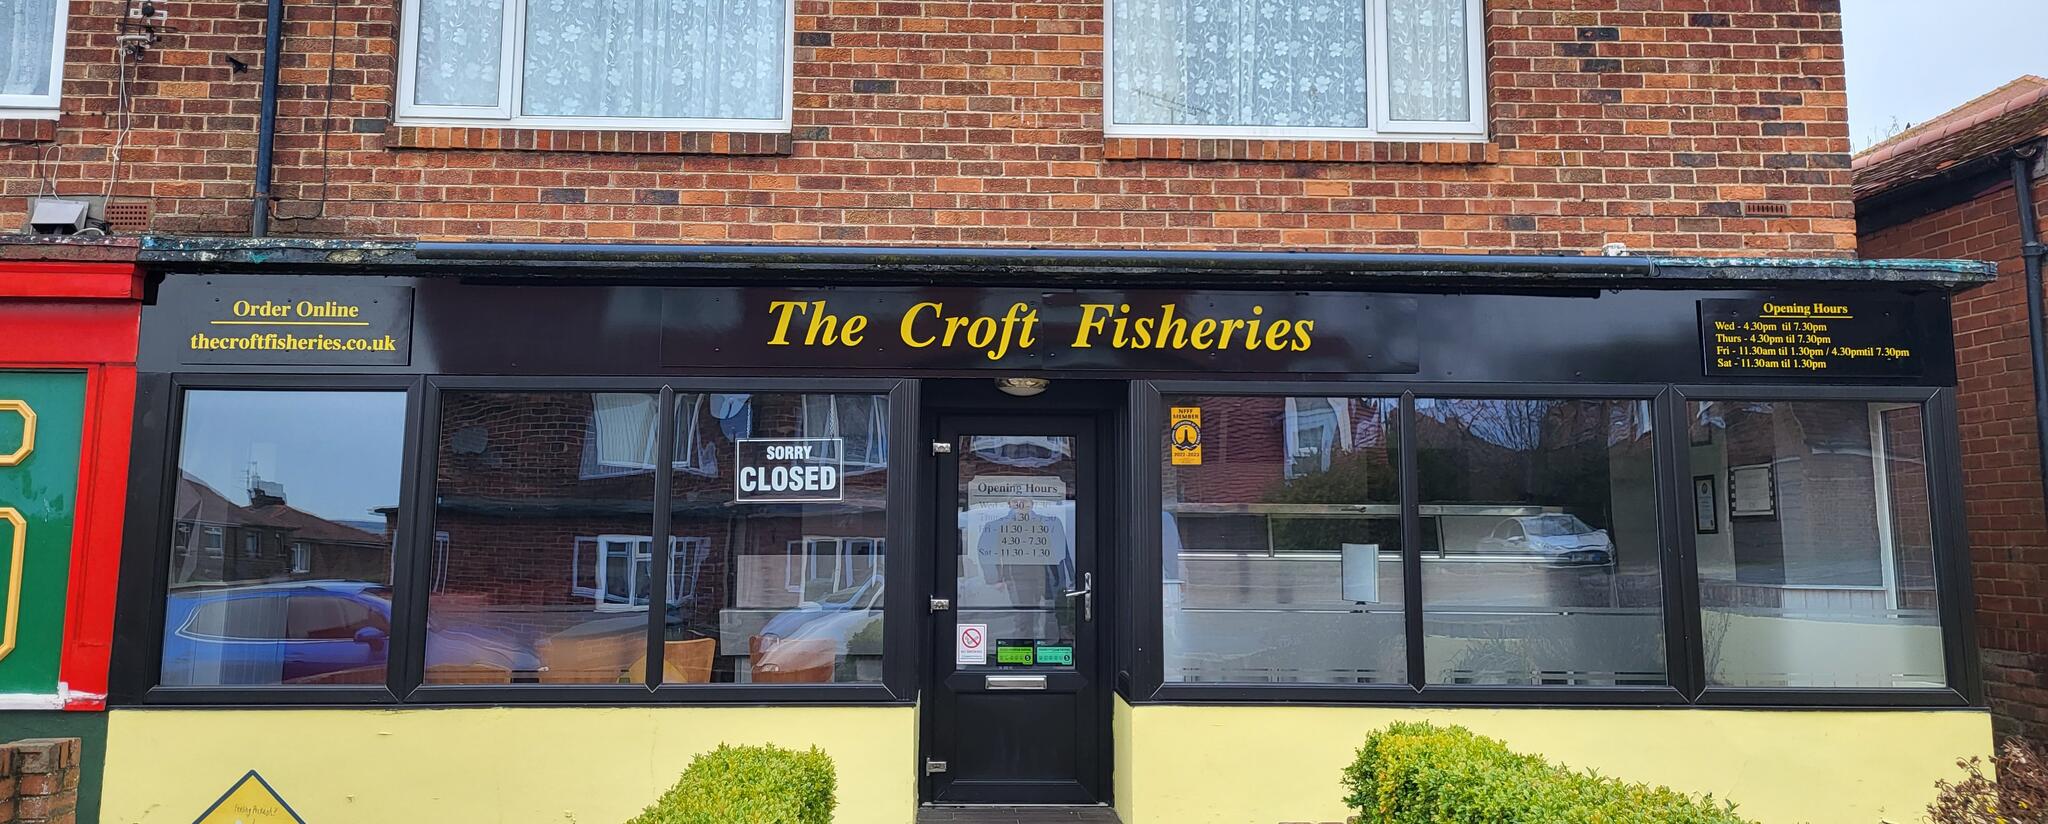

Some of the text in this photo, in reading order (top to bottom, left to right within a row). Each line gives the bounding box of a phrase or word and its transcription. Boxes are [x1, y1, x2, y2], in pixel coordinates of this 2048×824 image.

[233, 300, 359, 318] Order Online
[1763, 302, 1849, 316] Opening Hours
[767, 301, 1314, 360] The Croft Fisheries
[1715, 321, 1735, 331] Wed
[1743, 321, 1777, 333] 4.30pm
[1782, 321, 1791, 331] til
[1794, 322, 1827, 334] 7.30pm
[190, 333, 397, 351] thecroftfisheries.co.uk
[1715, 333, 1742, 343] Thurs
[1750, 333, 1784, 346] 4.30pm
[1786, 334, 1795, 343] til
[1797, 334, 1831, 346] 7.30pm
[1716, 345, 1730, 355] Fri
[1740, 346, 1776, 356] 11.30am
[1778, 346, 1788, 355] til
[1791, 346, 1824, 359] 1.30pm
[1875, 347, 1910, 359] 7.30pm
[1717, 358, 1732, 368] Sat
[1741, 358, 1779, 368] 11.30am
[1781, 358, 1790, 368] til
[1793, 358, 1827, 370] 1.30pm
[766, 445, 812, 460] SORRY
[740, 466, 836, 492] CLOSED
[978, 482, 1058, 494] Opening Hours
[1000, 525, 1023, 534] 11.30
[1032, 525, 1049, 534] 1.30
[1001, 537, 1020, 546] 4.30
[1028, 537, 1047, 546] 7.30
[979, 548, 992, 557] Sat
[1001, 549, 1023, 557] 11.30
[1033, 549, 1050, 557] 1.30
